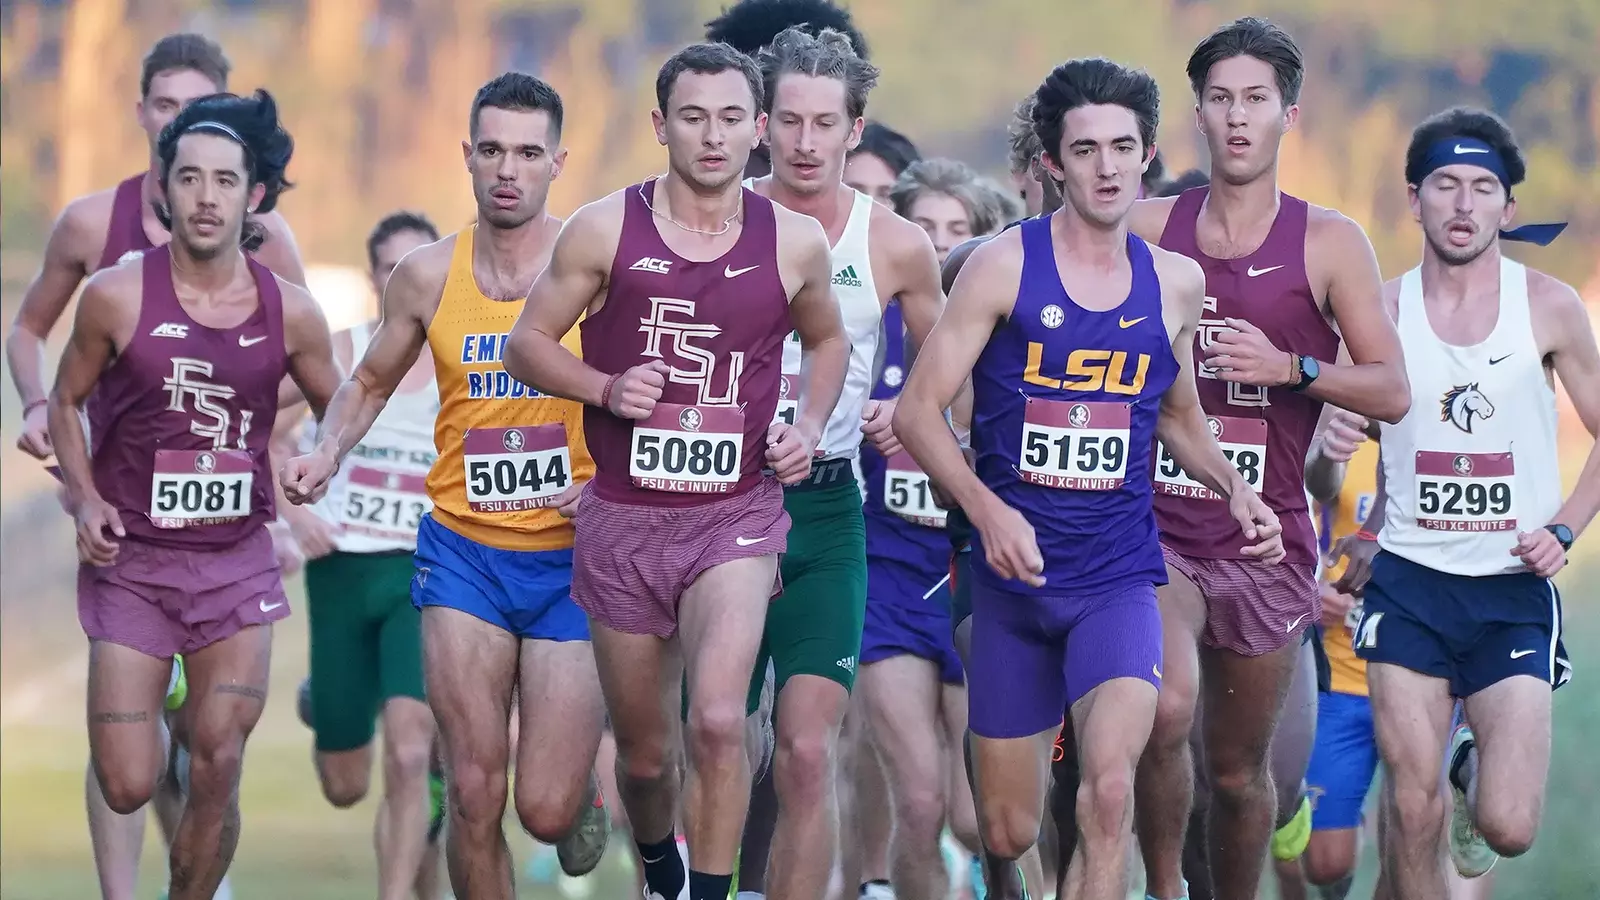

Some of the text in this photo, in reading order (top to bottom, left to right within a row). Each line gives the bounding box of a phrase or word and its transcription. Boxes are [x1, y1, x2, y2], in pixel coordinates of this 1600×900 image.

[629, 257, 673, 274] ACC
[830, 276, 862, 288] adidas
[1041, 305, 1064, 328] SEC
[150, 323, 190, 338] ACC
[638, 297, 745, 407] FSU
[1023, 341, 1151, 395] LSU
[636, 434, 737, 476] 5080
[1025, 431, 1124, 472] 5159
[470, 454, 568, 496] 5044
[641, 478, 727, 492] FSU XC INVITE
[1030, 472, 1115, 489] FSU XC INVITE
[156, 479, 242, 512] 5081
[1164, 483, 1187, 496] FSU
[1190, 487, 1207, 498] XC
[1419, 481, 1511, 516] 5299
[346, 491, 425, 528] 5213
[480, 501, 501, 512] FSU
[505, 500, 520, 511] XC
[161, 517, 184, 528] FSU
[1426, 520, 1506, 531] FSU XC INVITE
